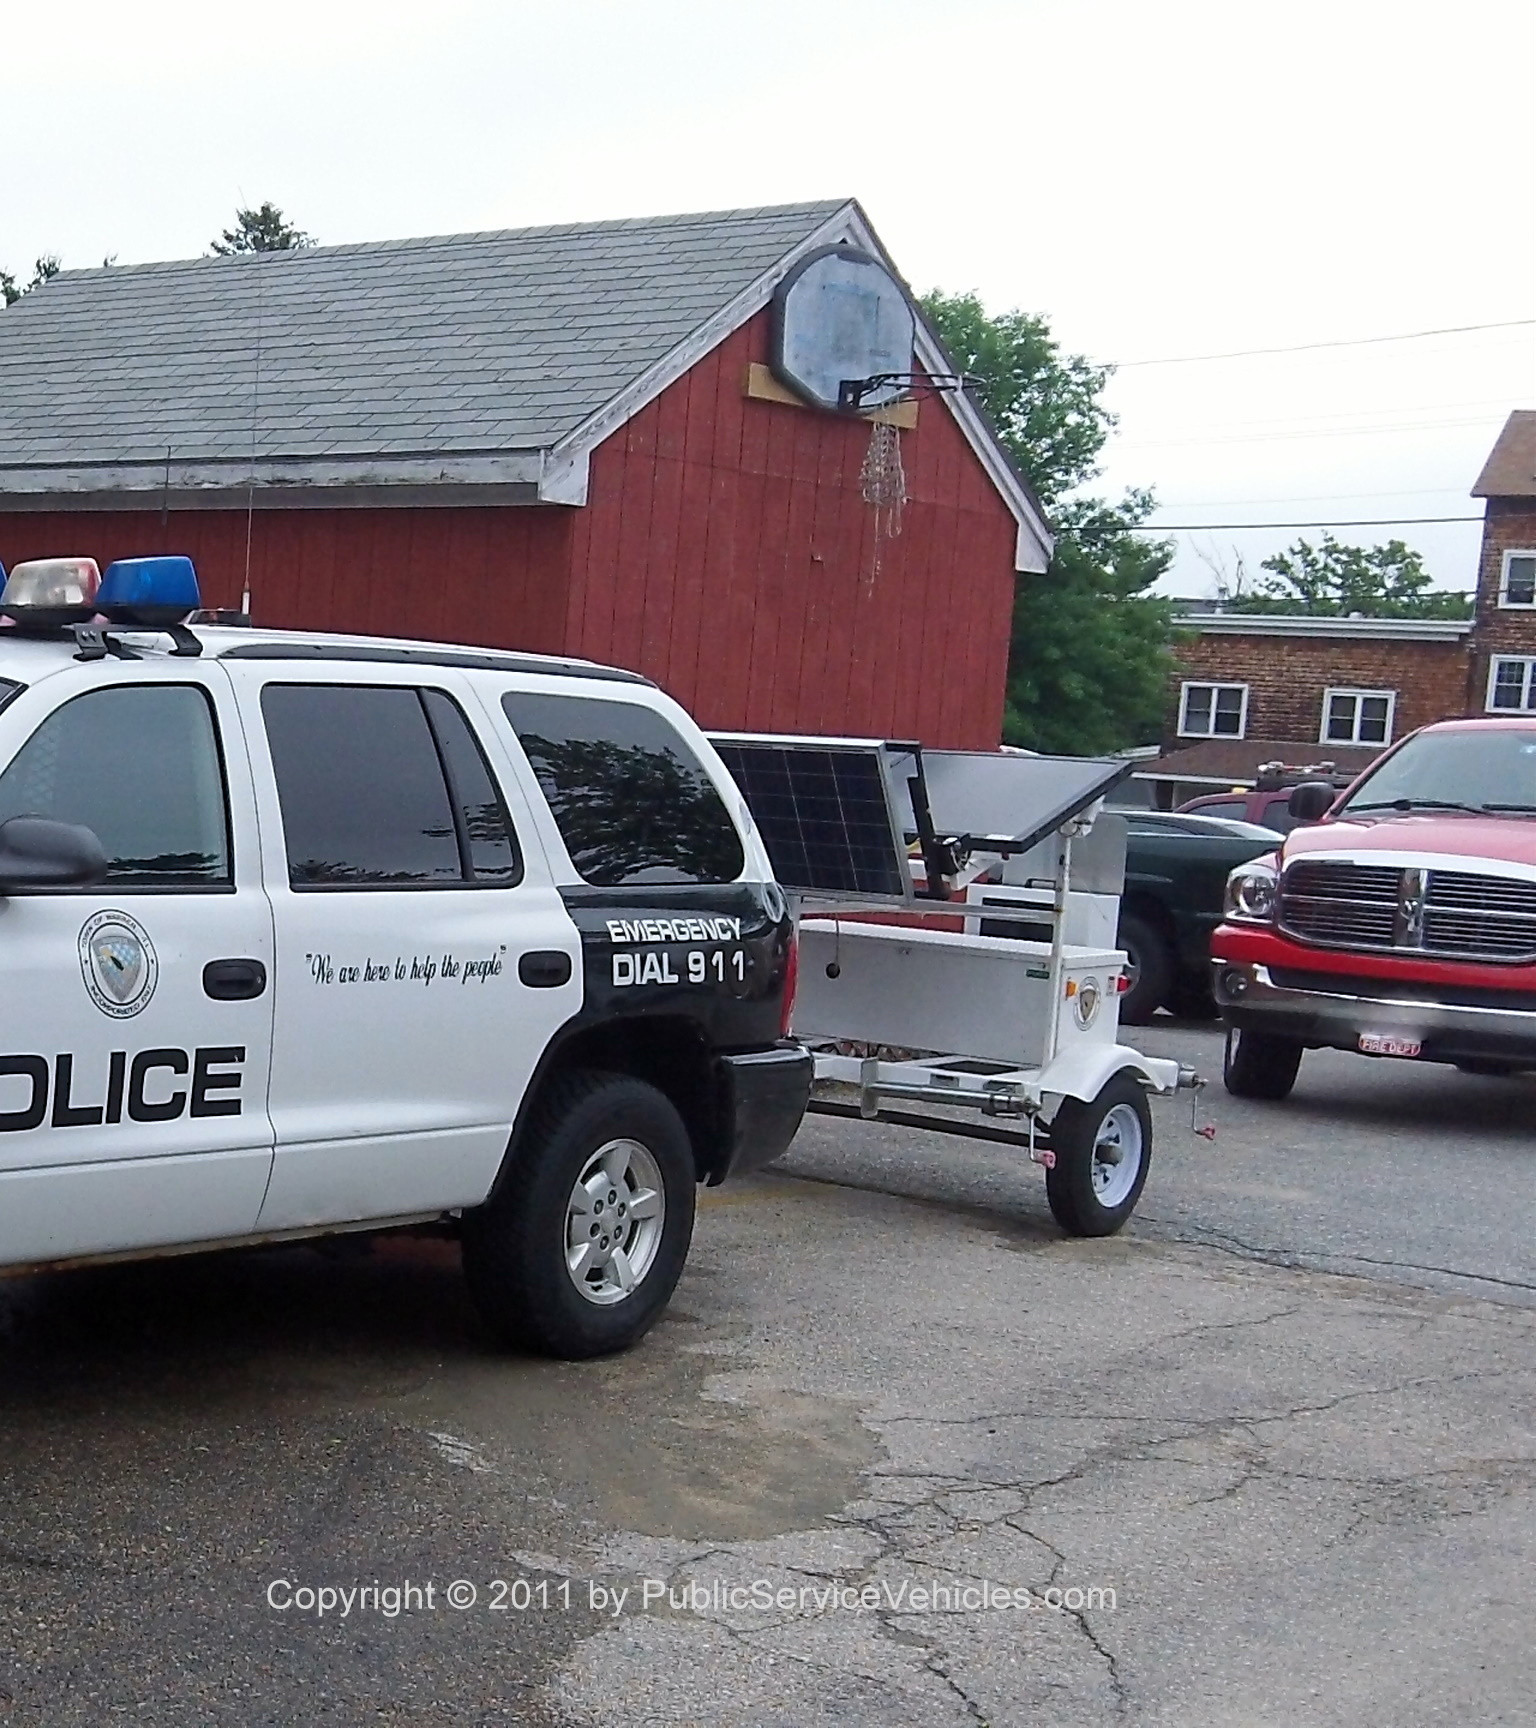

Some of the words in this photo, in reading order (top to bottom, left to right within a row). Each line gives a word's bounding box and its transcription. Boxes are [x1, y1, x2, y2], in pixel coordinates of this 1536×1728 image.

[606, 917, 741, 942] EMERGENCY
[339, 964, 361, 984] are
[363, 957, 390, 983] here
[394, 957, 406, 981] to
[409, 955, 437, 987] help
[440, 954, 460, 978] the
[613, 952, 679, 986] DIAL
[688, 951, 744, 983] 911
